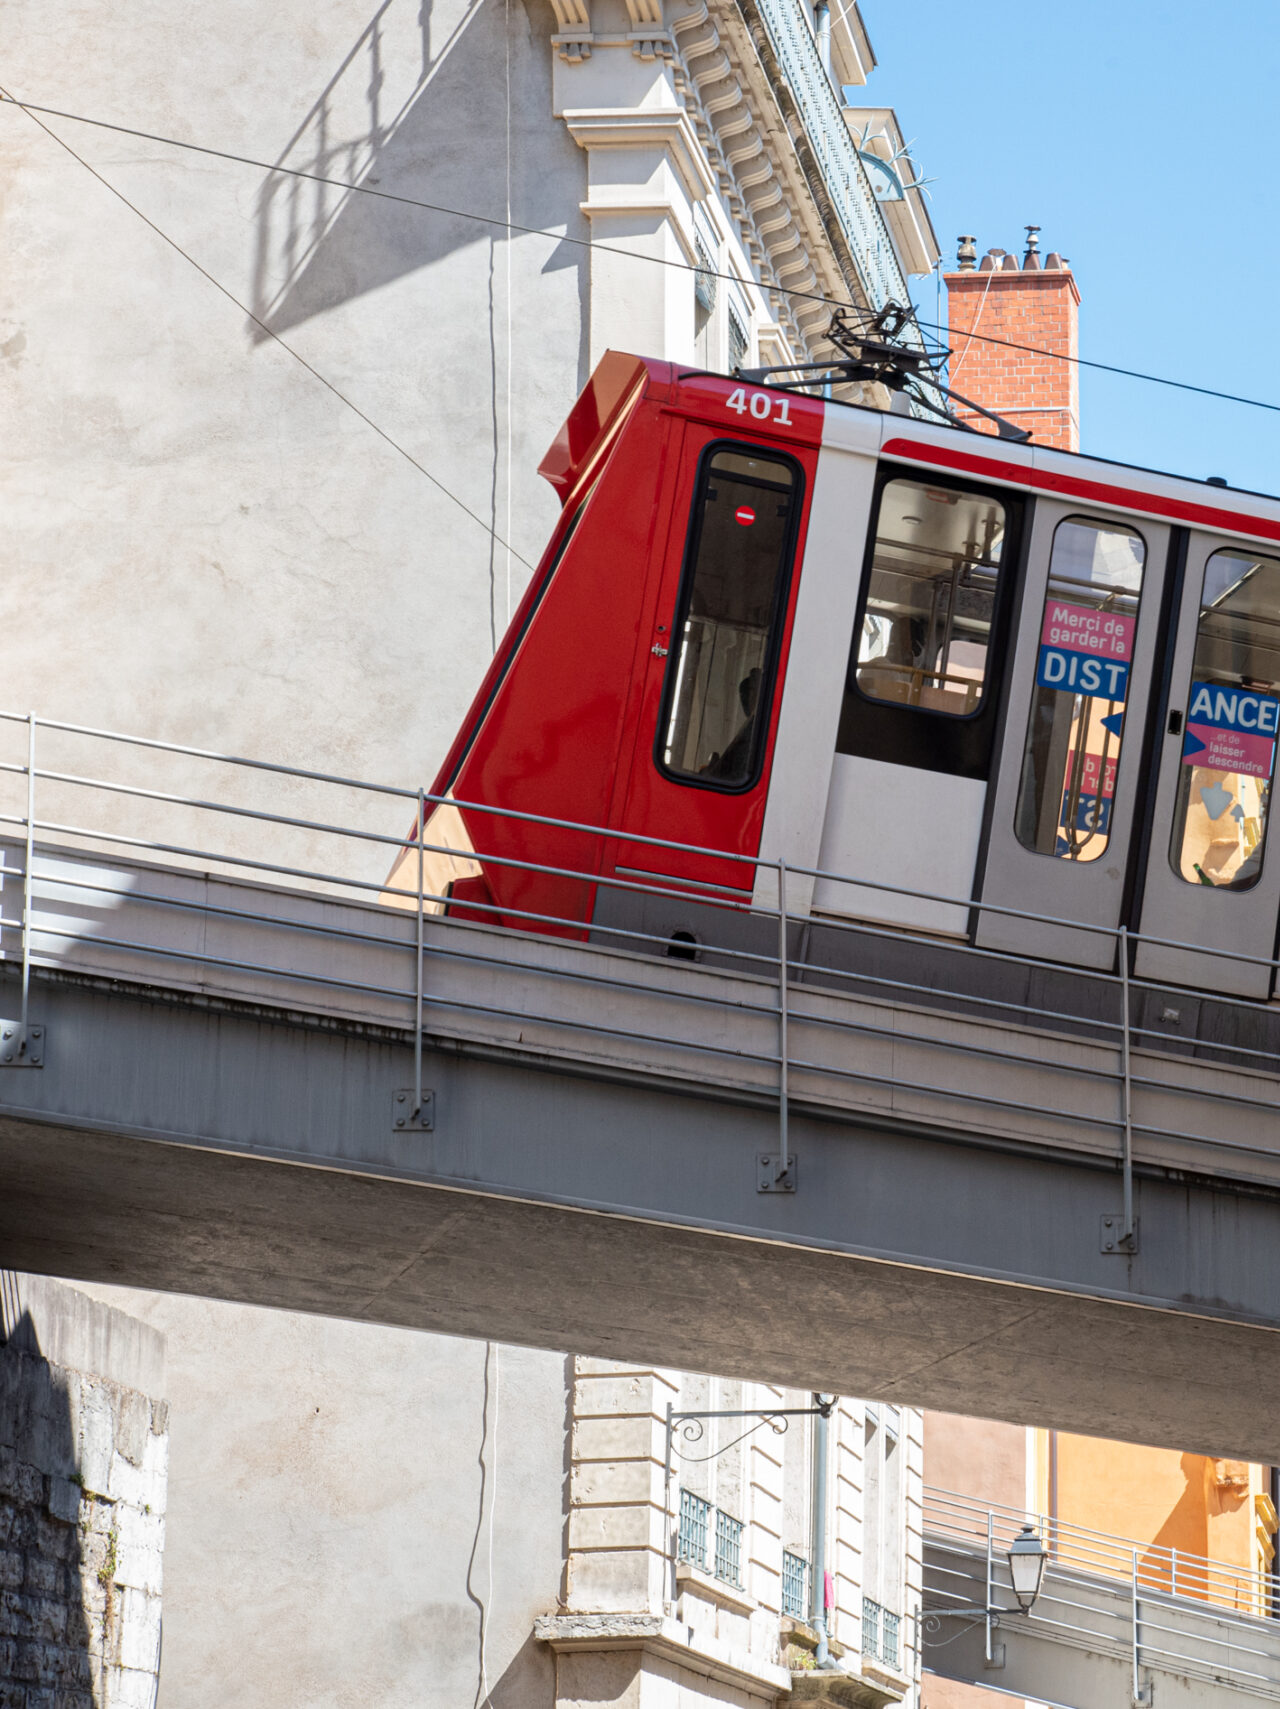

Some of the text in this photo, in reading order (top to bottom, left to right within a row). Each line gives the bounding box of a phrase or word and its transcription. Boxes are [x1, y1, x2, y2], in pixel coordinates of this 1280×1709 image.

[726, 388, 793, 426] 401
[1052, 607, 1125, 637] Merci de
[1049, 627, 1125, 654] garder la
[1043, 651, 1126, 695] DIST
[1190, 688, 1277, 732] ANCE
[1209, 741, 1245, 757] laisser
[1228, 734, 1240, 745] de
[1207, 754, 1263, 773] descendre
